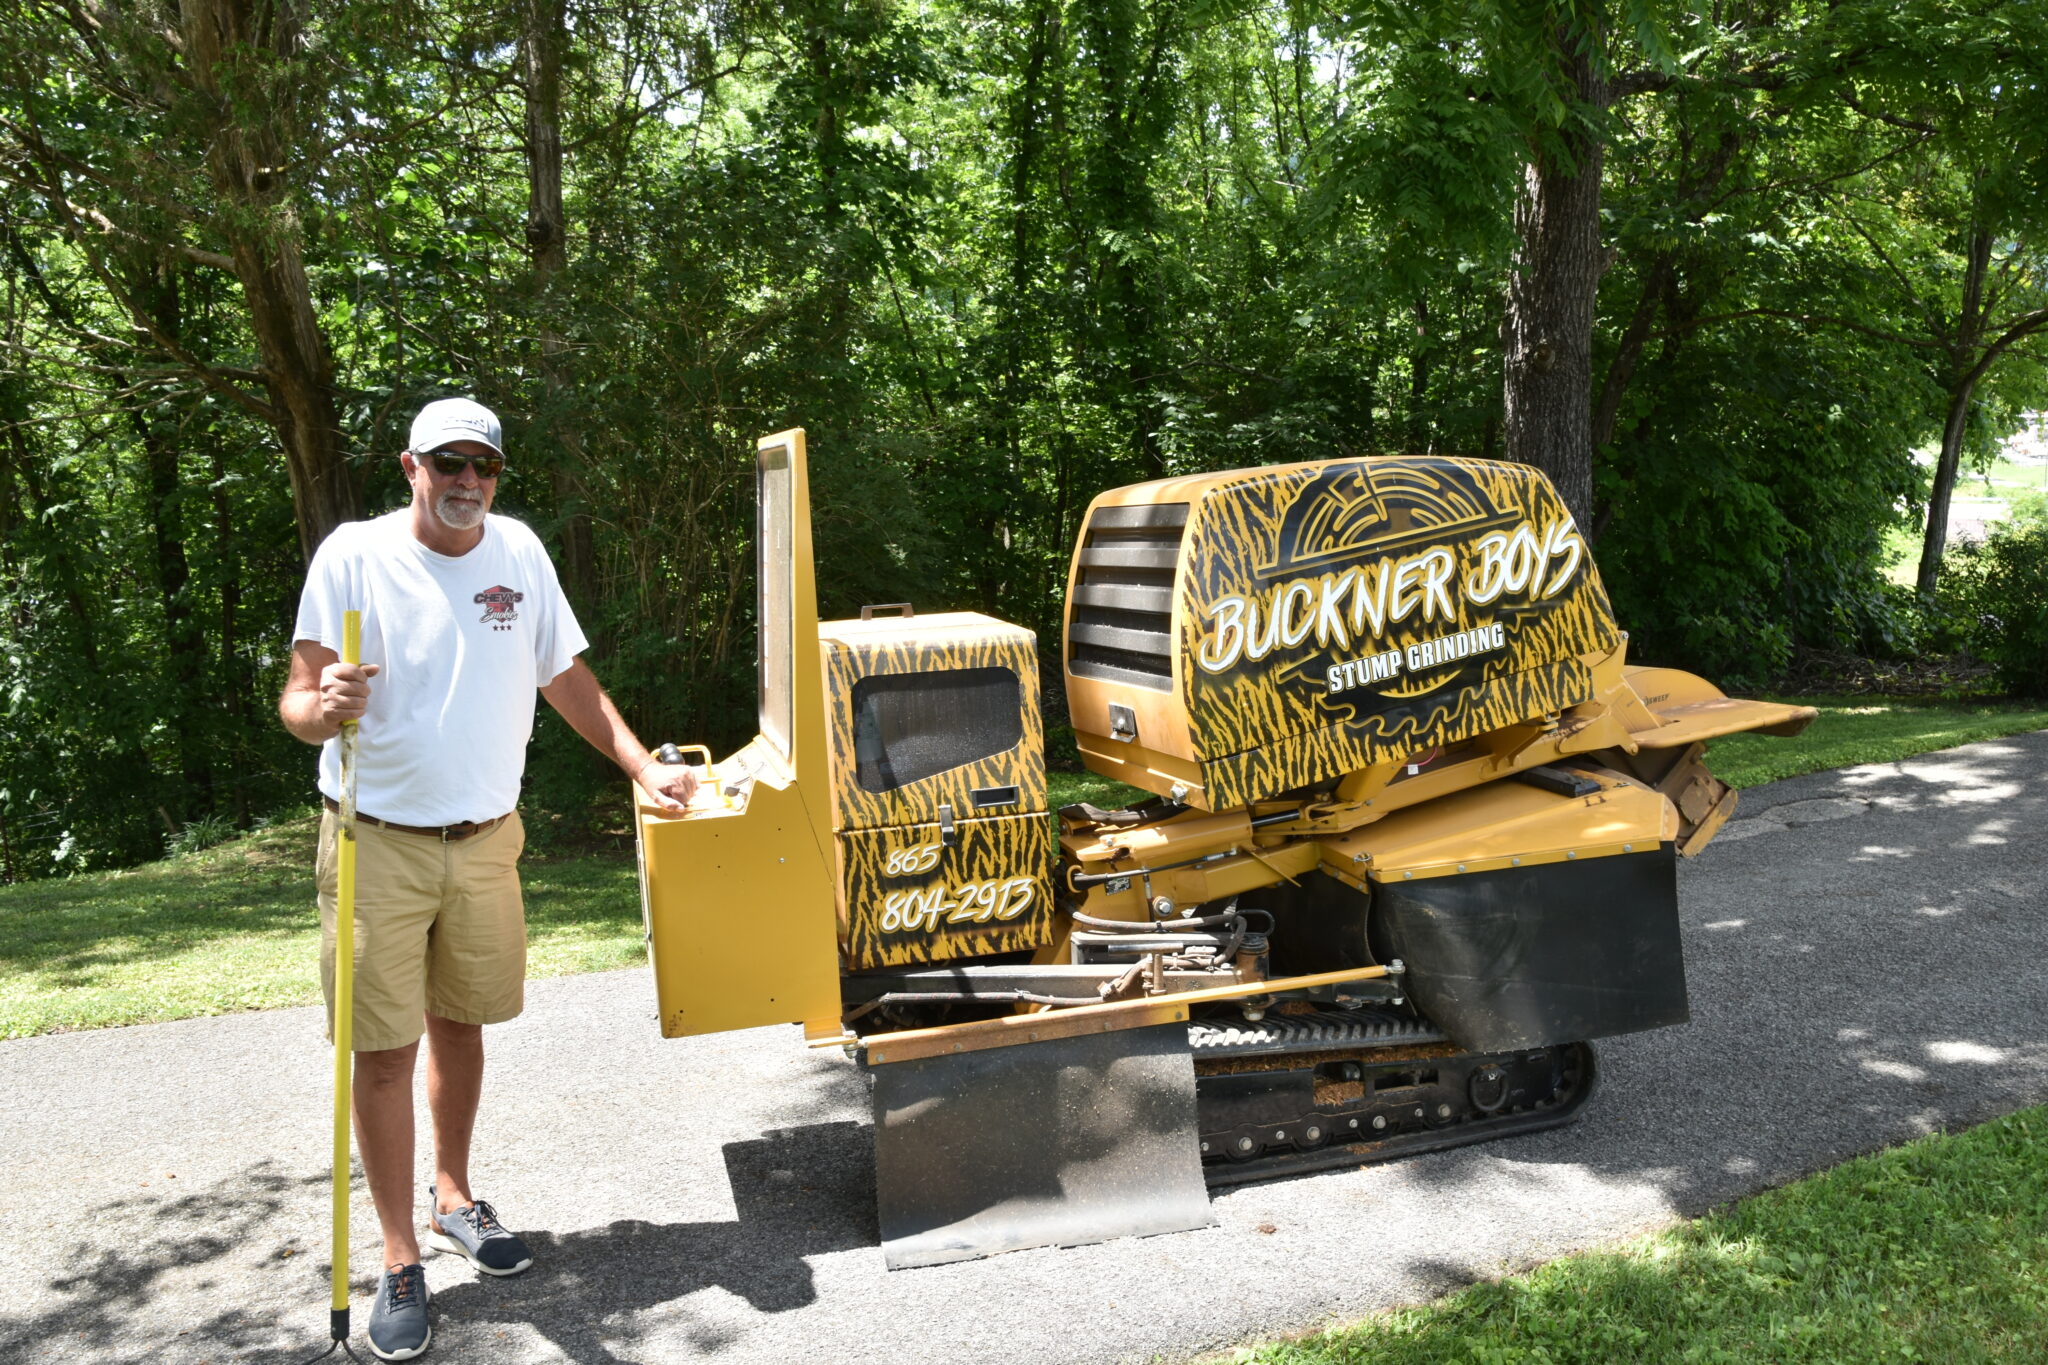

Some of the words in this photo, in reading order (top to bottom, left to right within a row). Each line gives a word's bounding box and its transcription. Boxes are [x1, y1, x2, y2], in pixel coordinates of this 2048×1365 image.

[473, 592, 524, 604] CHEVYS
[1200, 550, 1455, 671] BUCKNER
[1468, 517, 1581, 604] BOYS
[1327, 651, 1403, 693] STUMP
[1406, 622, 1505, 672] GRINDING
[886, 844, 941, 875] 865
[881, 878, 1034, 931] 804-2913
